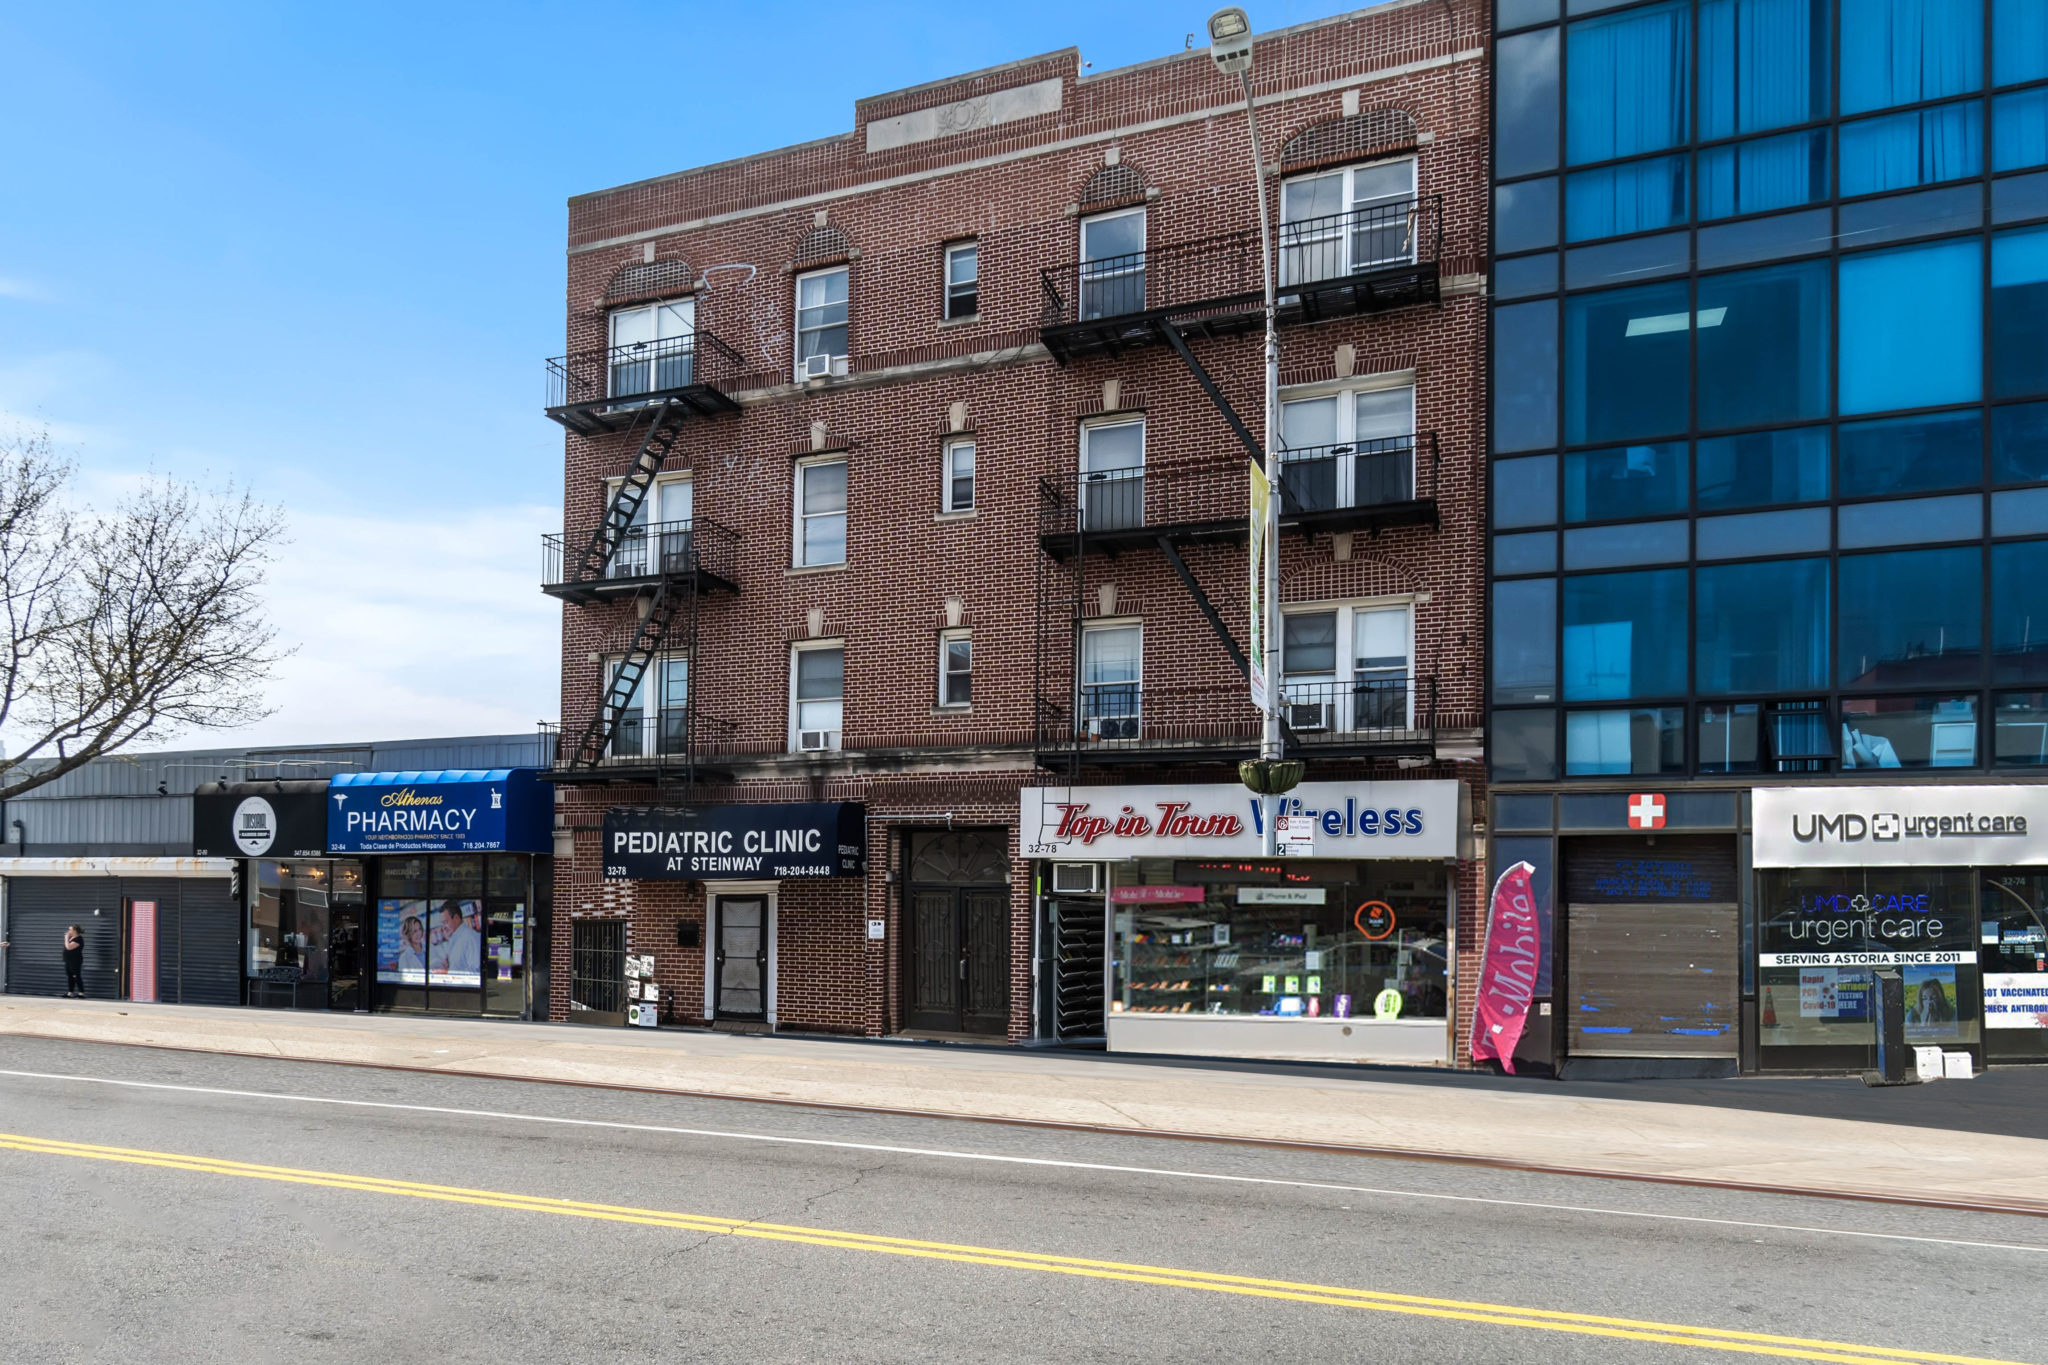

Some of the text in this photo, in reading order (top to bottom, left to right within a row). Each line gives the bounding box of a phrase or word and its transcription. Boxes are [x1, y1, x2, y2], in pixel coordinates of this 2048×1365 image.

[380, 787, 444, 807] Athenas
[347, 808, 477, 832] PHARMACY
[1056, 803, 1112, 845] Top
[1112, 805, 1150, 837] in
[1155, 801, 1244, 837] Town
[1792, 813, 2028, 843] UMD urgent care
[422, 842, 446, 850] Hispanos
[614, 828, 821, 854] PEDIATRIC CLINIC
[1028, 844, 1057, 854] 32-78
[838, 844, 859, 856] PEDIATRIC
[608, 866, 626, 876] 32-78
[666, 856, 763, 871] AT STEINWAY
[774, 866, 830, 876] 718-204-8448
[1801, 894, 1929, 913] UMD CARE
[1789, 915, 1944, 945] urgent care
[1776, 953, 1960, 965] SERVING ASTORIA SINCE 2011
